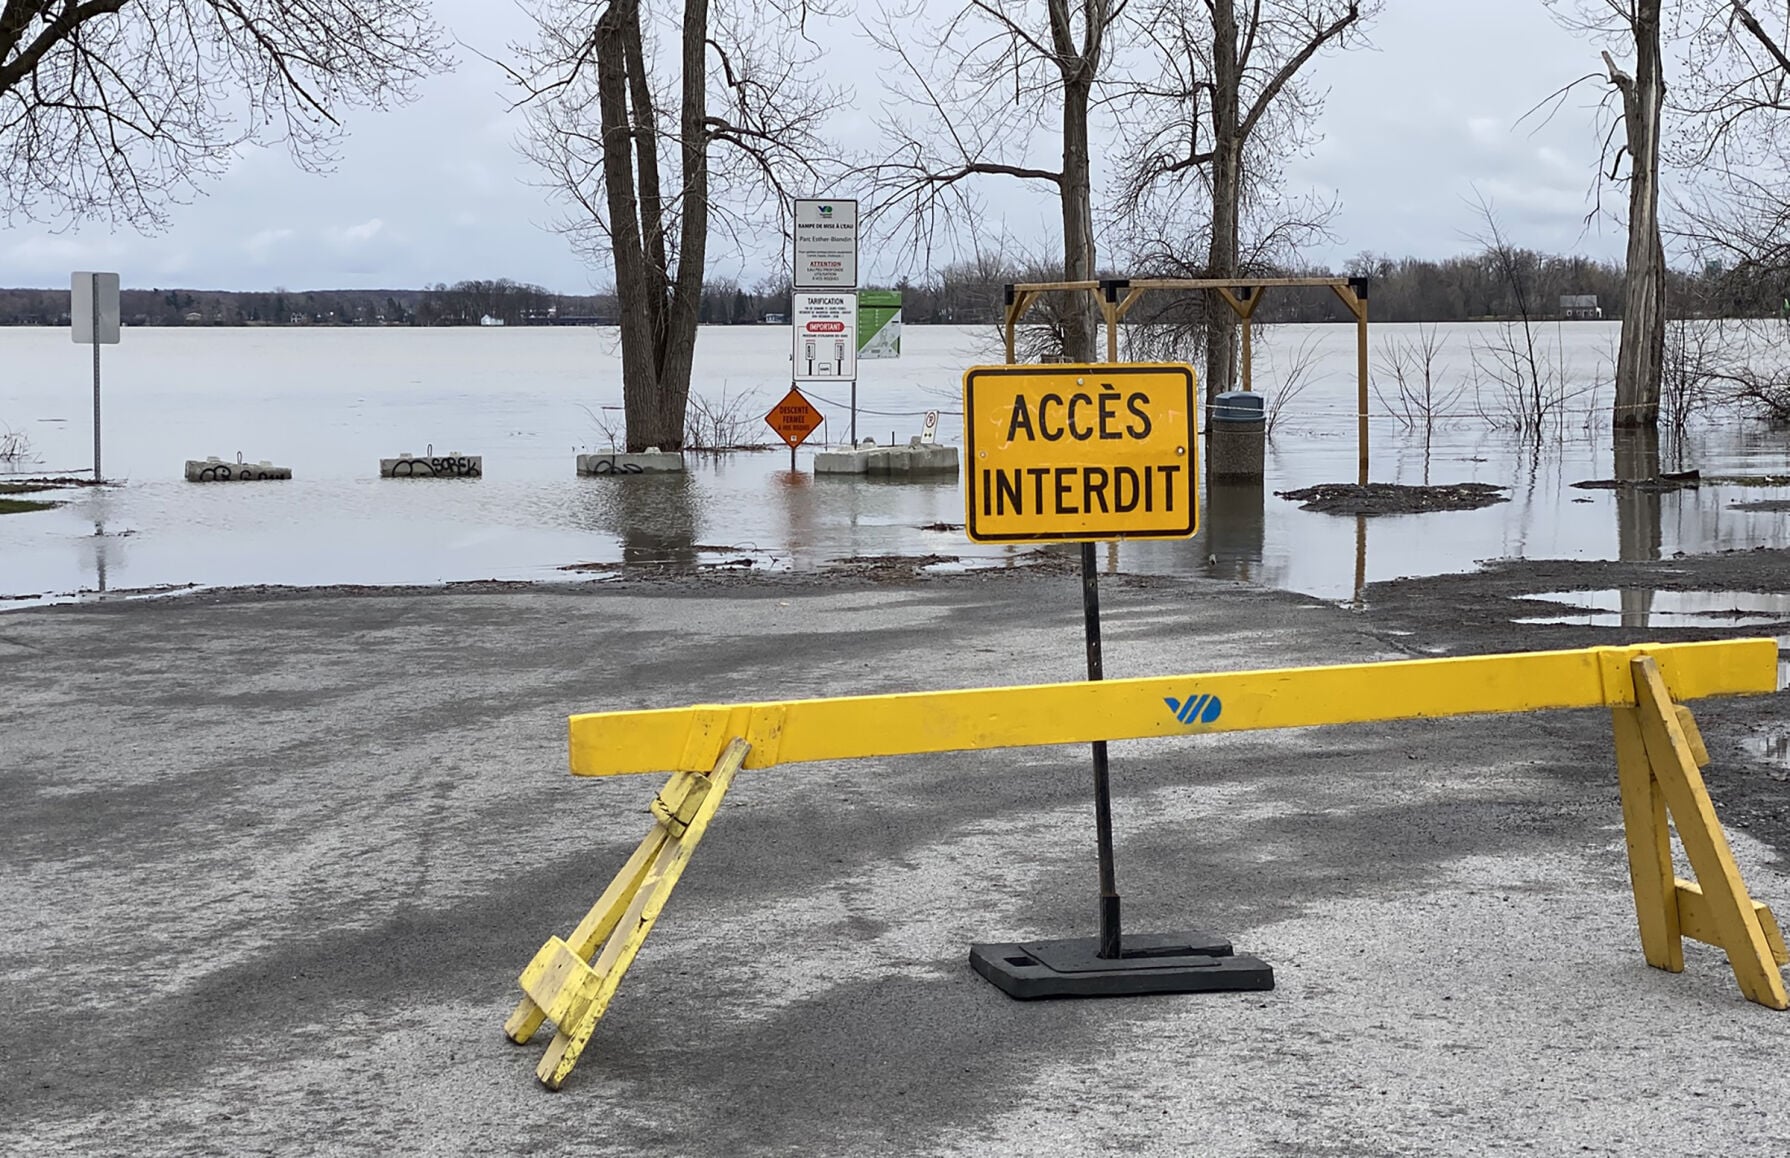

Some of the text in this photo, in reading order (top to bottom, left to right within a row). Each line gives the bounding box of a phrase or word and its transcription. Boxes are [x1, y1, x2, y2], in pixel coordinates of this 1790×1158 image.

[808, 297, 844, 305] TARIFICATION
[810, 323, 841, 331] IMPORTANT
[780, 406, 808, 414] DESCENTE
[1006, 383, 1152, 441] ACCÈS
[983, 465, 1181, 516] INTERDIT
